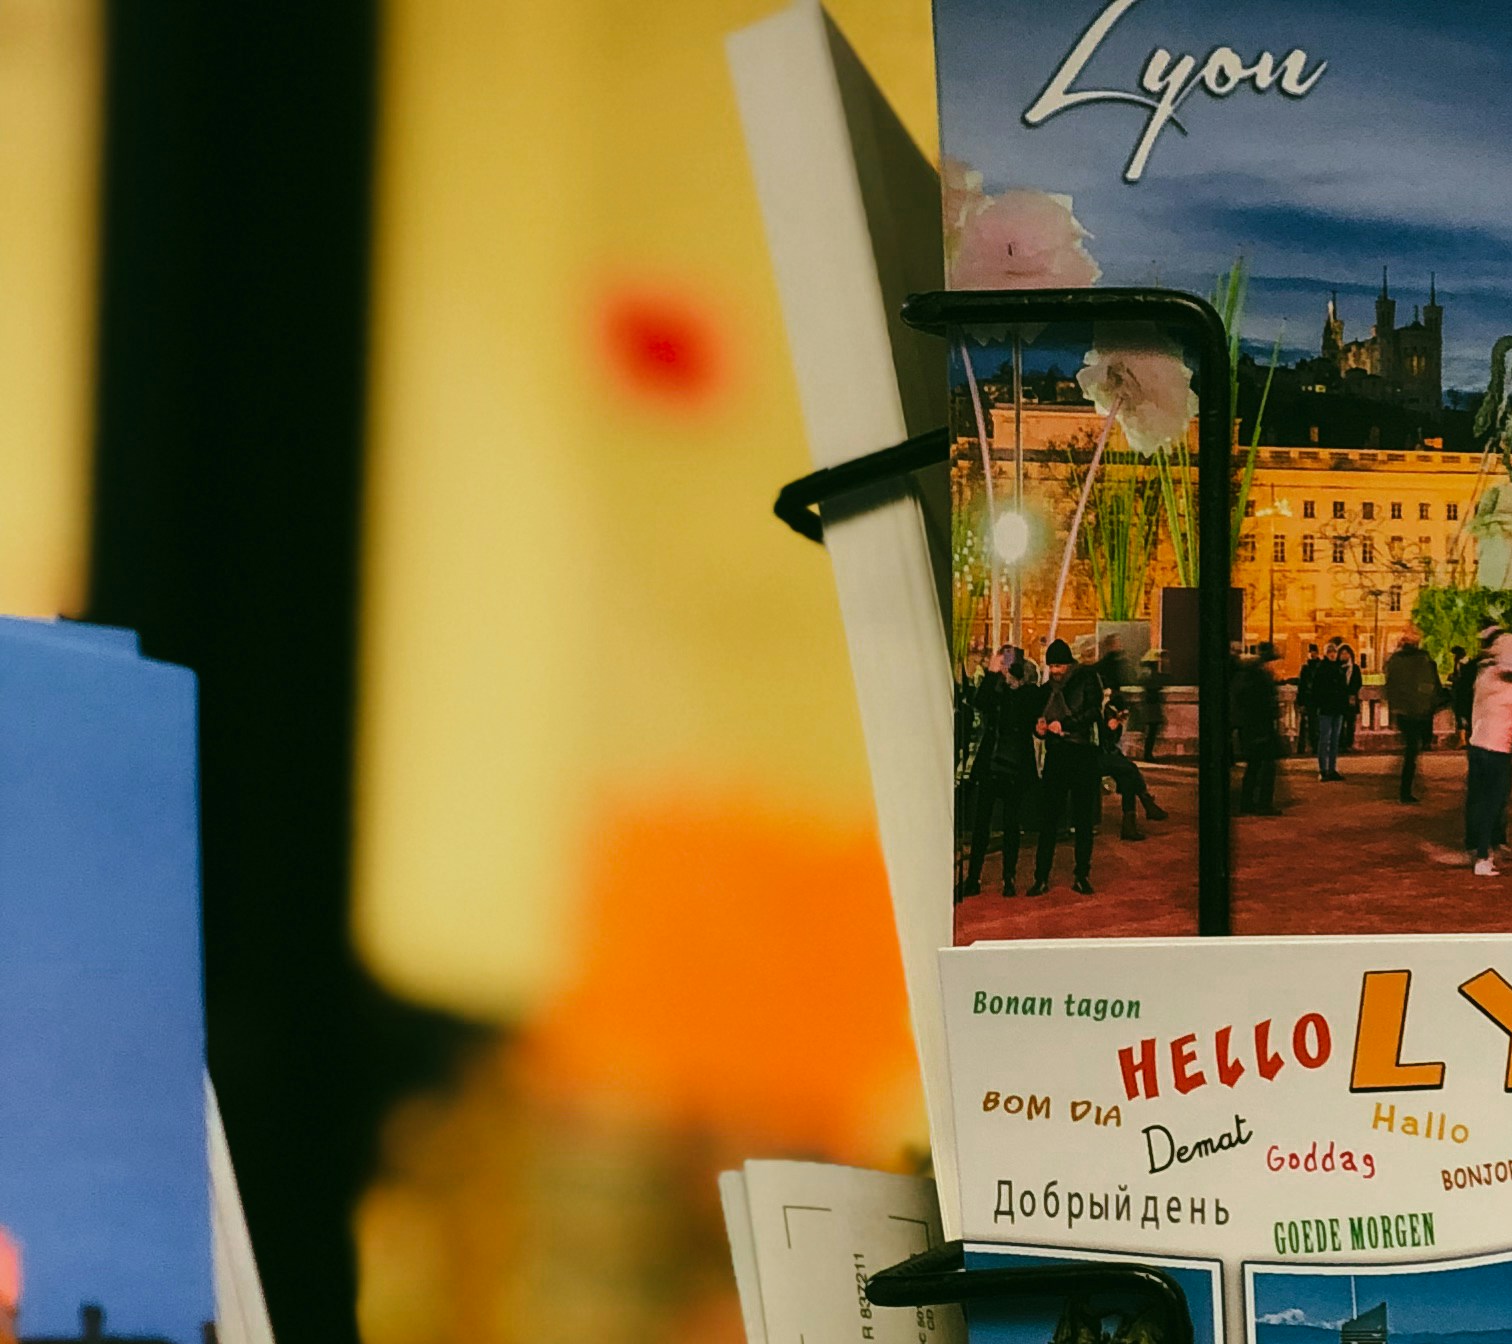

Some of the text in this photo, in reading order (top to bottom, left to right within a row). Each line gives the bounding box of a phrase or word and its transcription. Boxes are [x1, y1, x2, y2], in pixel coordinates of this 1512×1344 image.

[1021, 0, 1328, 183] Lyon
[972, 990, 1142, 1021] Bonan tagon
[1118, 1012, 1332, 1101] HELLO
[982, 1090, 1122, 1128] BOM DIA
[1372, 1102, 1470, 1145] Hallo
[1142, 1113, 1253, 1174] Demat
[1267, 1141, 1376, 1179] Goddag
[993, 1179, 1231, 1229] Добрый день
[1274, 1212, 1436, 1255] GOEDE MORGEN
